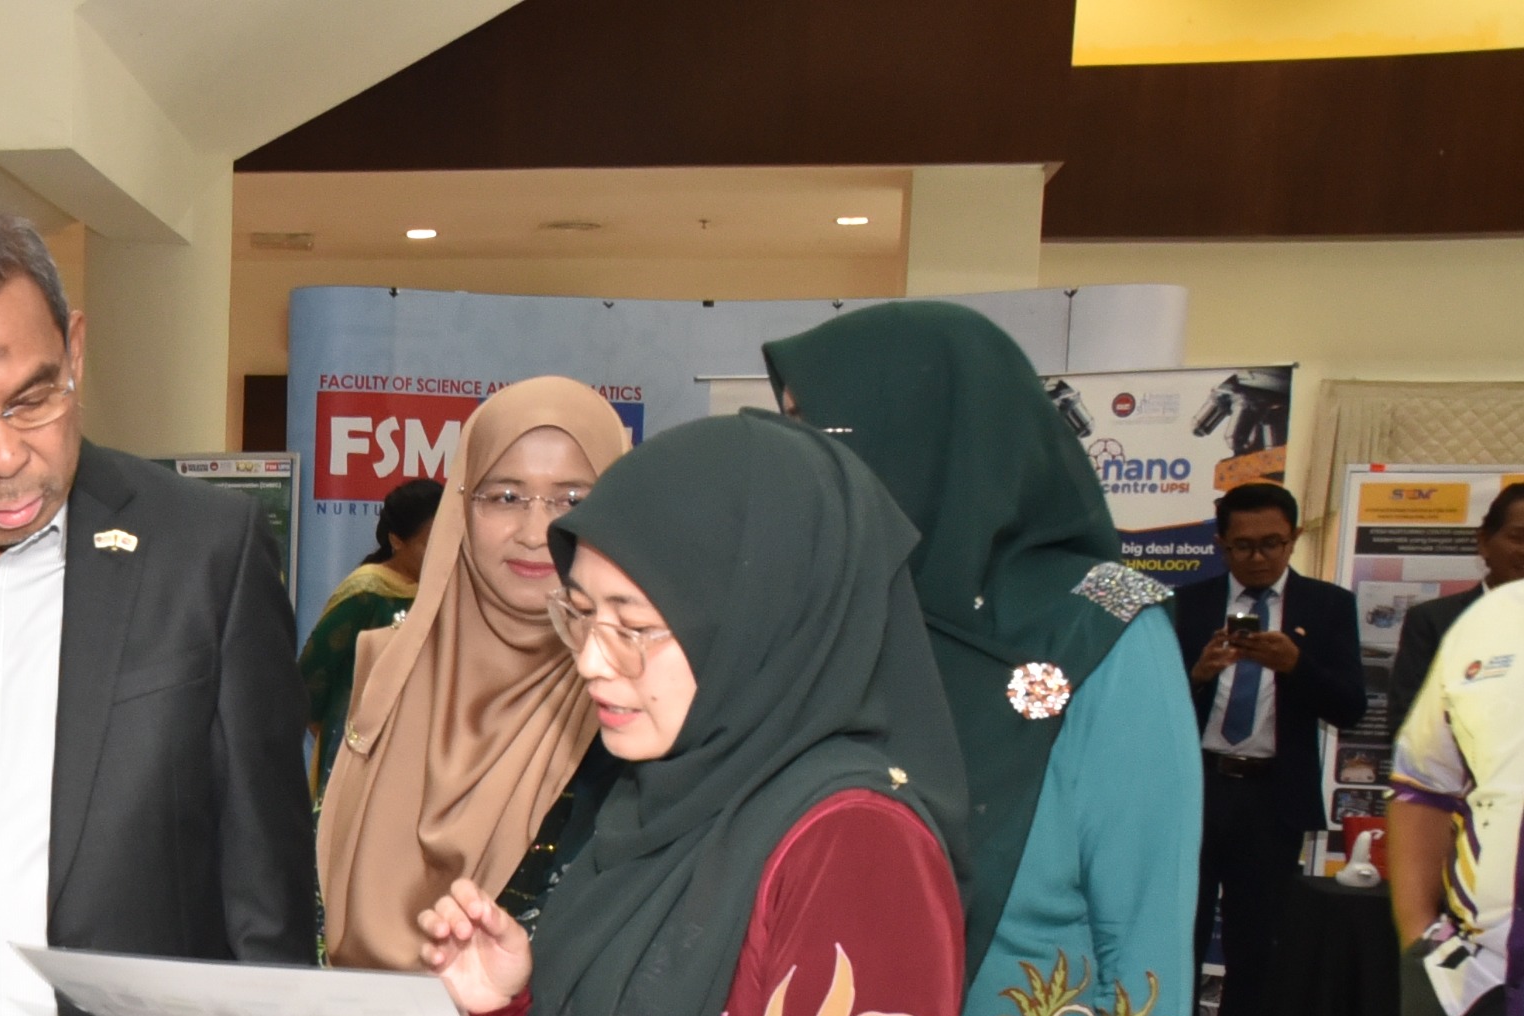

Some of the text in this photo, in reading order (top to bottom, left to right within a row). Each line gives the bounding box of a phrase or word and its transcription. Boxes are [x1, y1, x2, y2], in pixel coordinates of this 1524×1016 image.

[319, 374, 389, 390] FACULTY
[392, 376, 413, 391] OF
[416, 378, 482, 395] SCIENCE
[329, 415, 462, 479] FSM
[1102, 458, 1191, 481] nano
[1103, 482, 1190, 494] centre UPSI
[1121, 543, 1215, 556] big deal about
